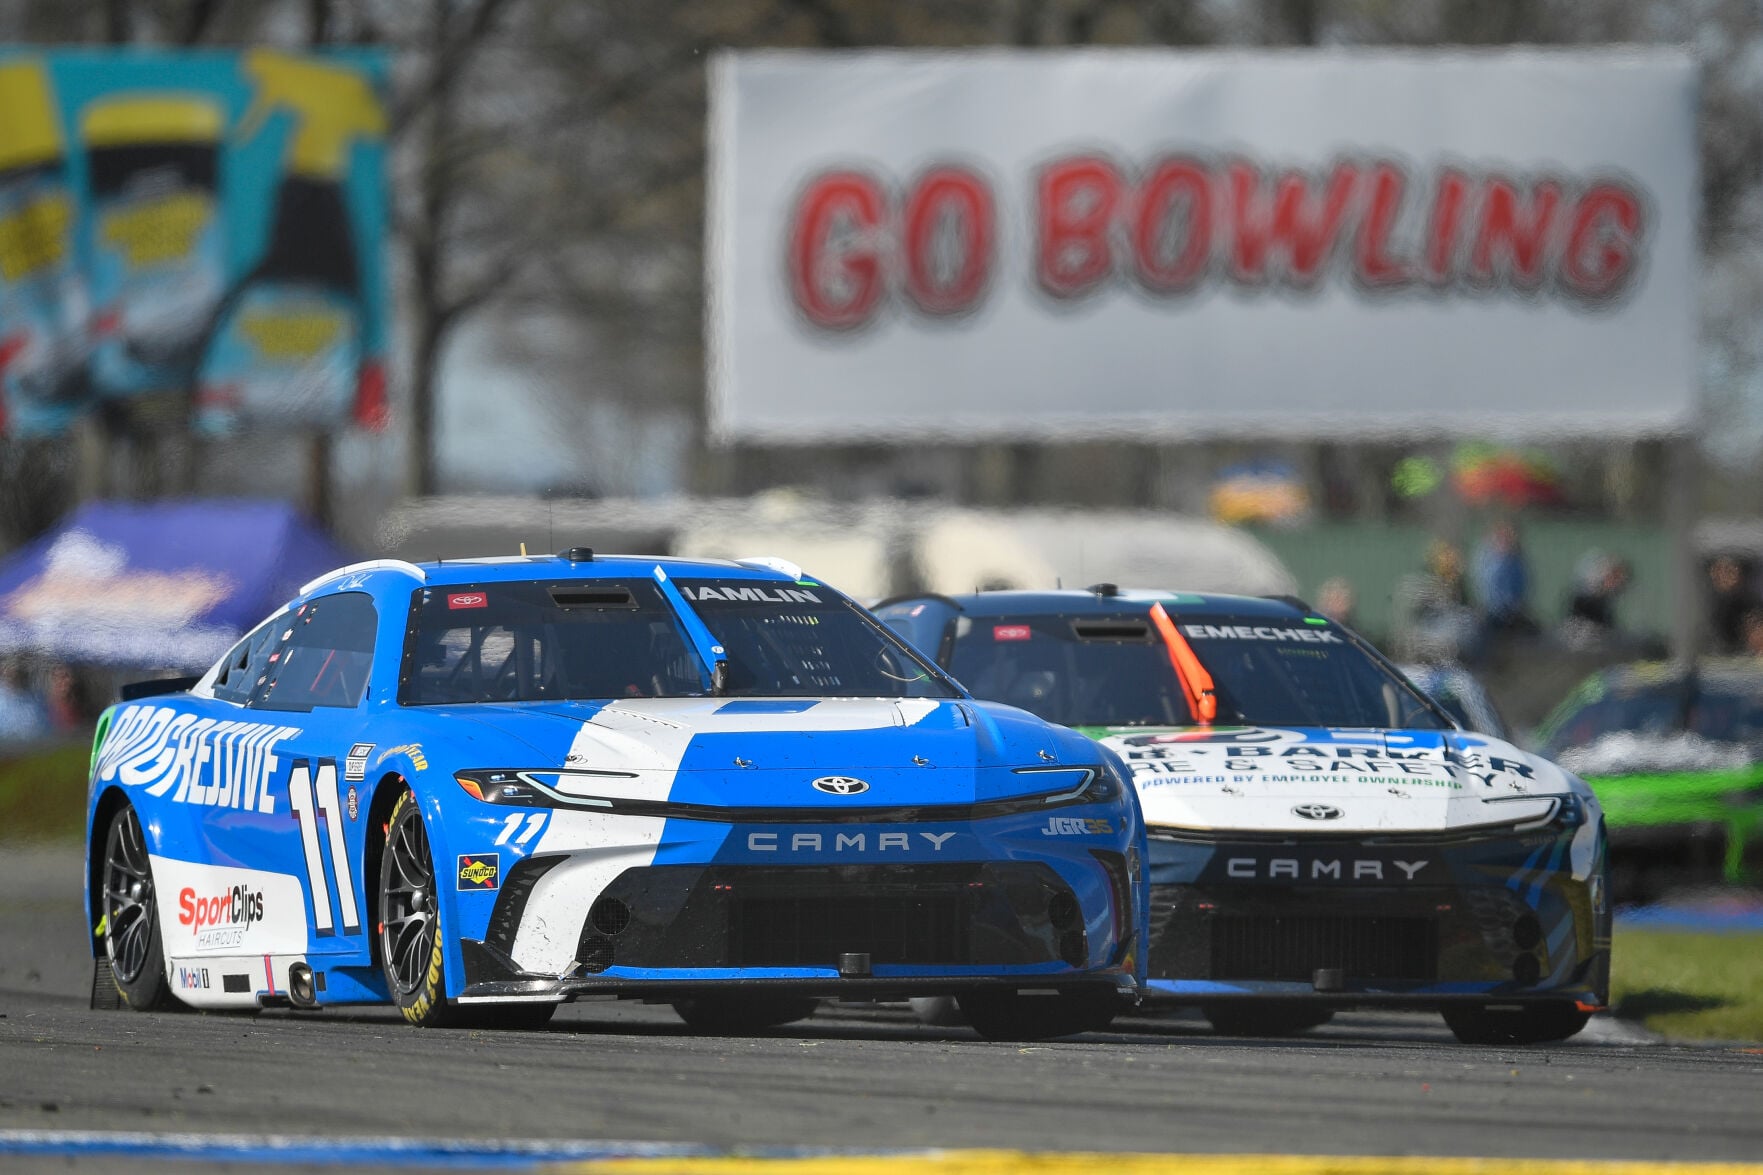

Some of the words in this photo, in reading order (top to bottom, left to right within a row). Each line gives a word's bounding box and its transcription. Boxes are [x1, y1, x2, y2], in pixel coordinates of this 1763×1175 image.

[788, 161, 1000, 332] GO
[1034, 151, 1648, 307] BOWLING
[1184, 624, 1343, 643] EMECHEK
[97, 705, 303, 815] PROGRESSIVE
[1142, 775, 1225, 789] POWERED
[1233, 775, 1253, 783] BY
[1262, 775, 1347, 783] EMPLOYEE
[1358, 776, 1463, 789] OWNERSHIP
[1224, 759, 1259, 771] &
[1285, 759, 1498, 787] SAFETY
[494, 812, 548, 846] 11
[288, 759, 361, 937] 11
[747, 832, 957, 851] CAMRY
[461, 866, 496, 878] SUNOCO
[1227, 858, 1429, 880] CAMRY
[198, 930, 243, 948] HAIRCUTS
[180, 967, 202, 989] Mobil
